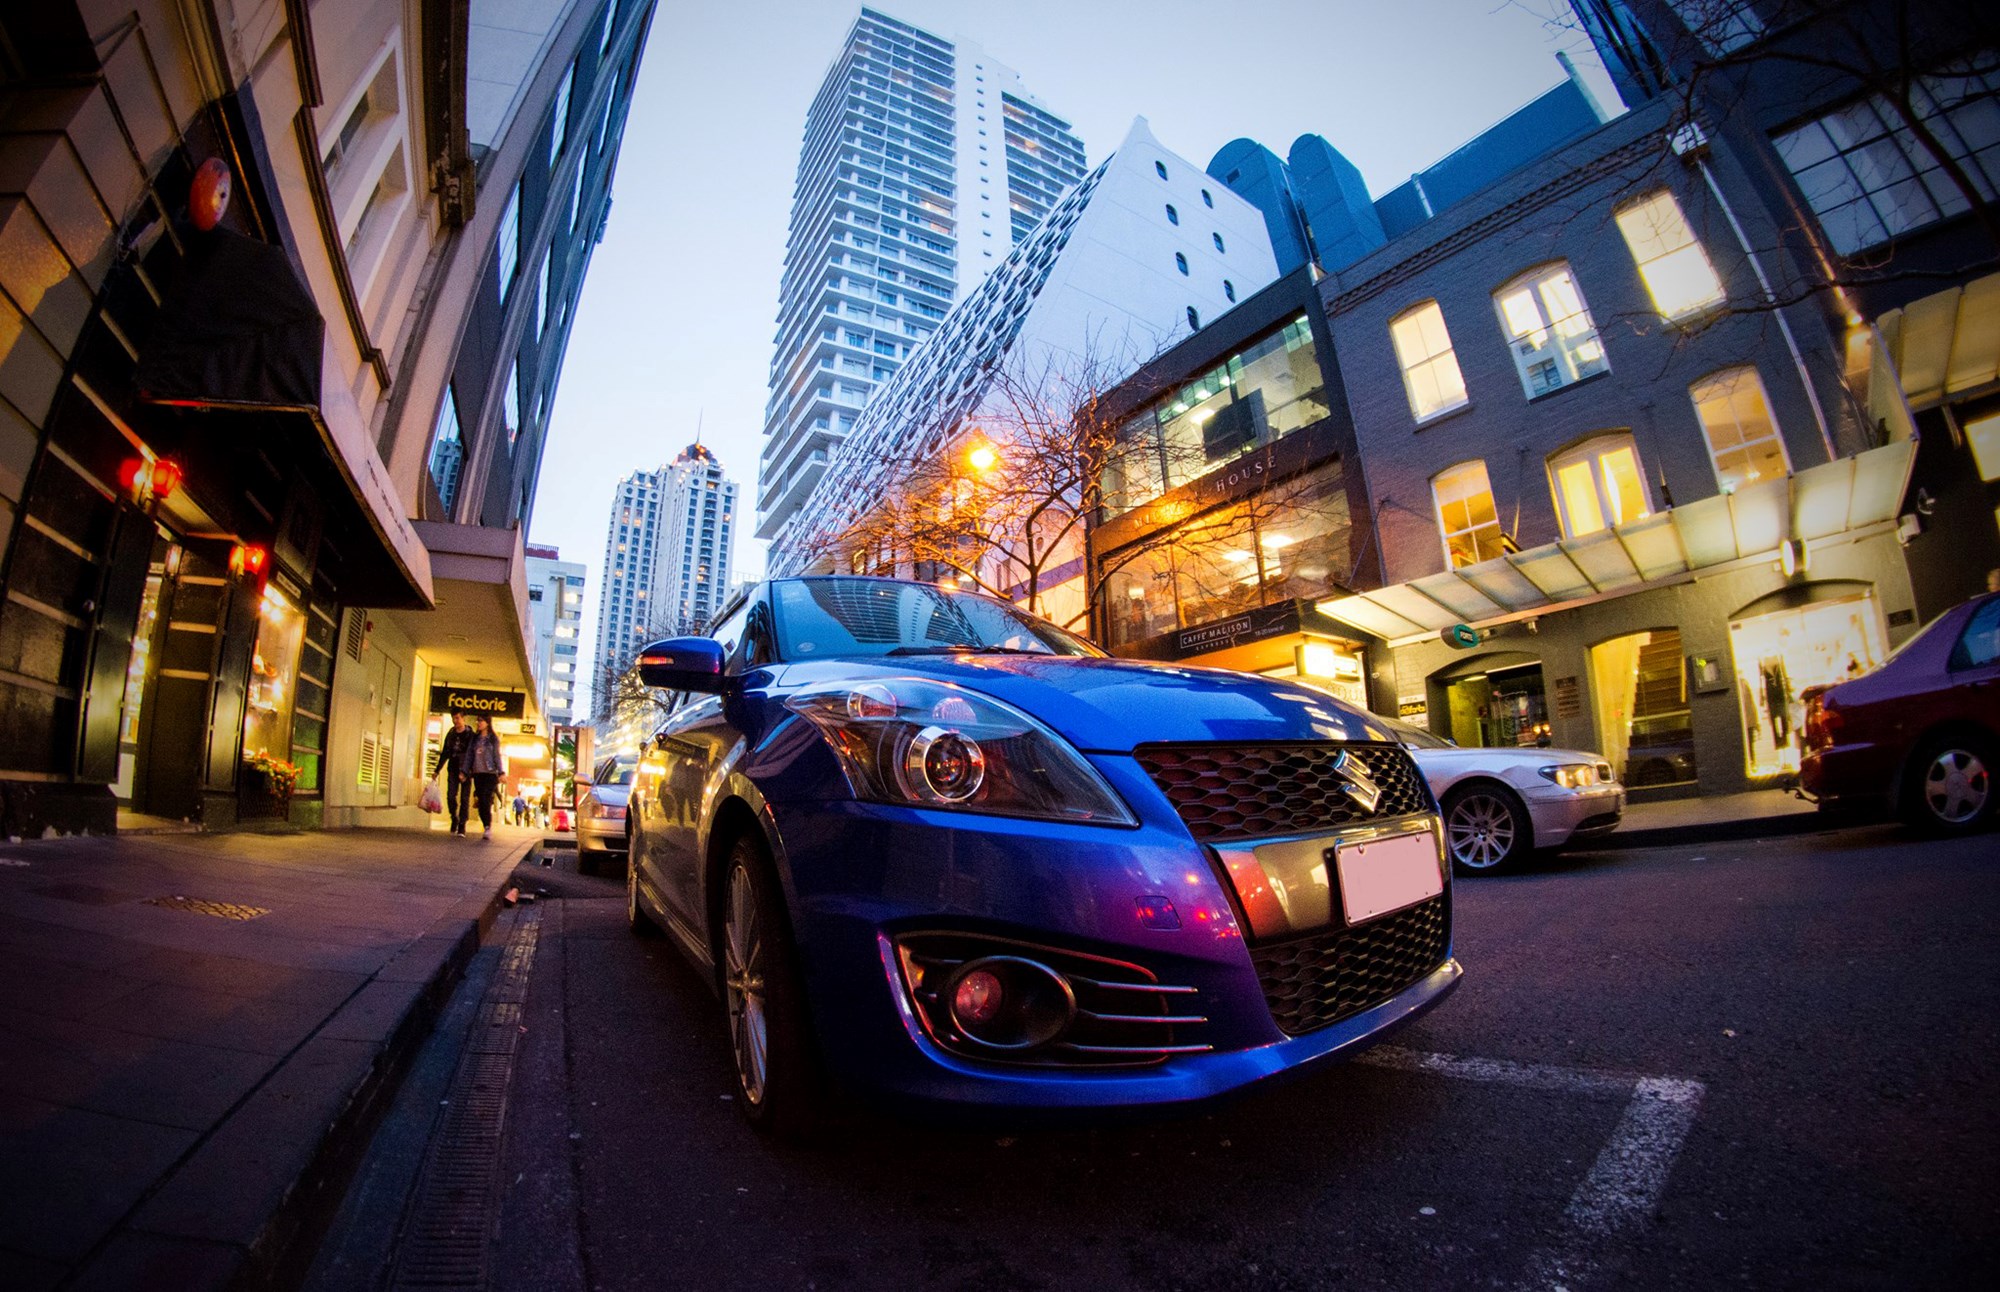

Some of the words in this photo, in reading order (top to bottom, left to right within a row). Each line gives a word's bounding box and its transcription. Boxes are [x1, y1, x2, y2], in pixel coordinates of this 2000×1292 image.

[1215, 455, 1277, 493] HOUSE
[1209, 621, 1249, 638] MADISON
[448, 692, 507, 712] factorie
